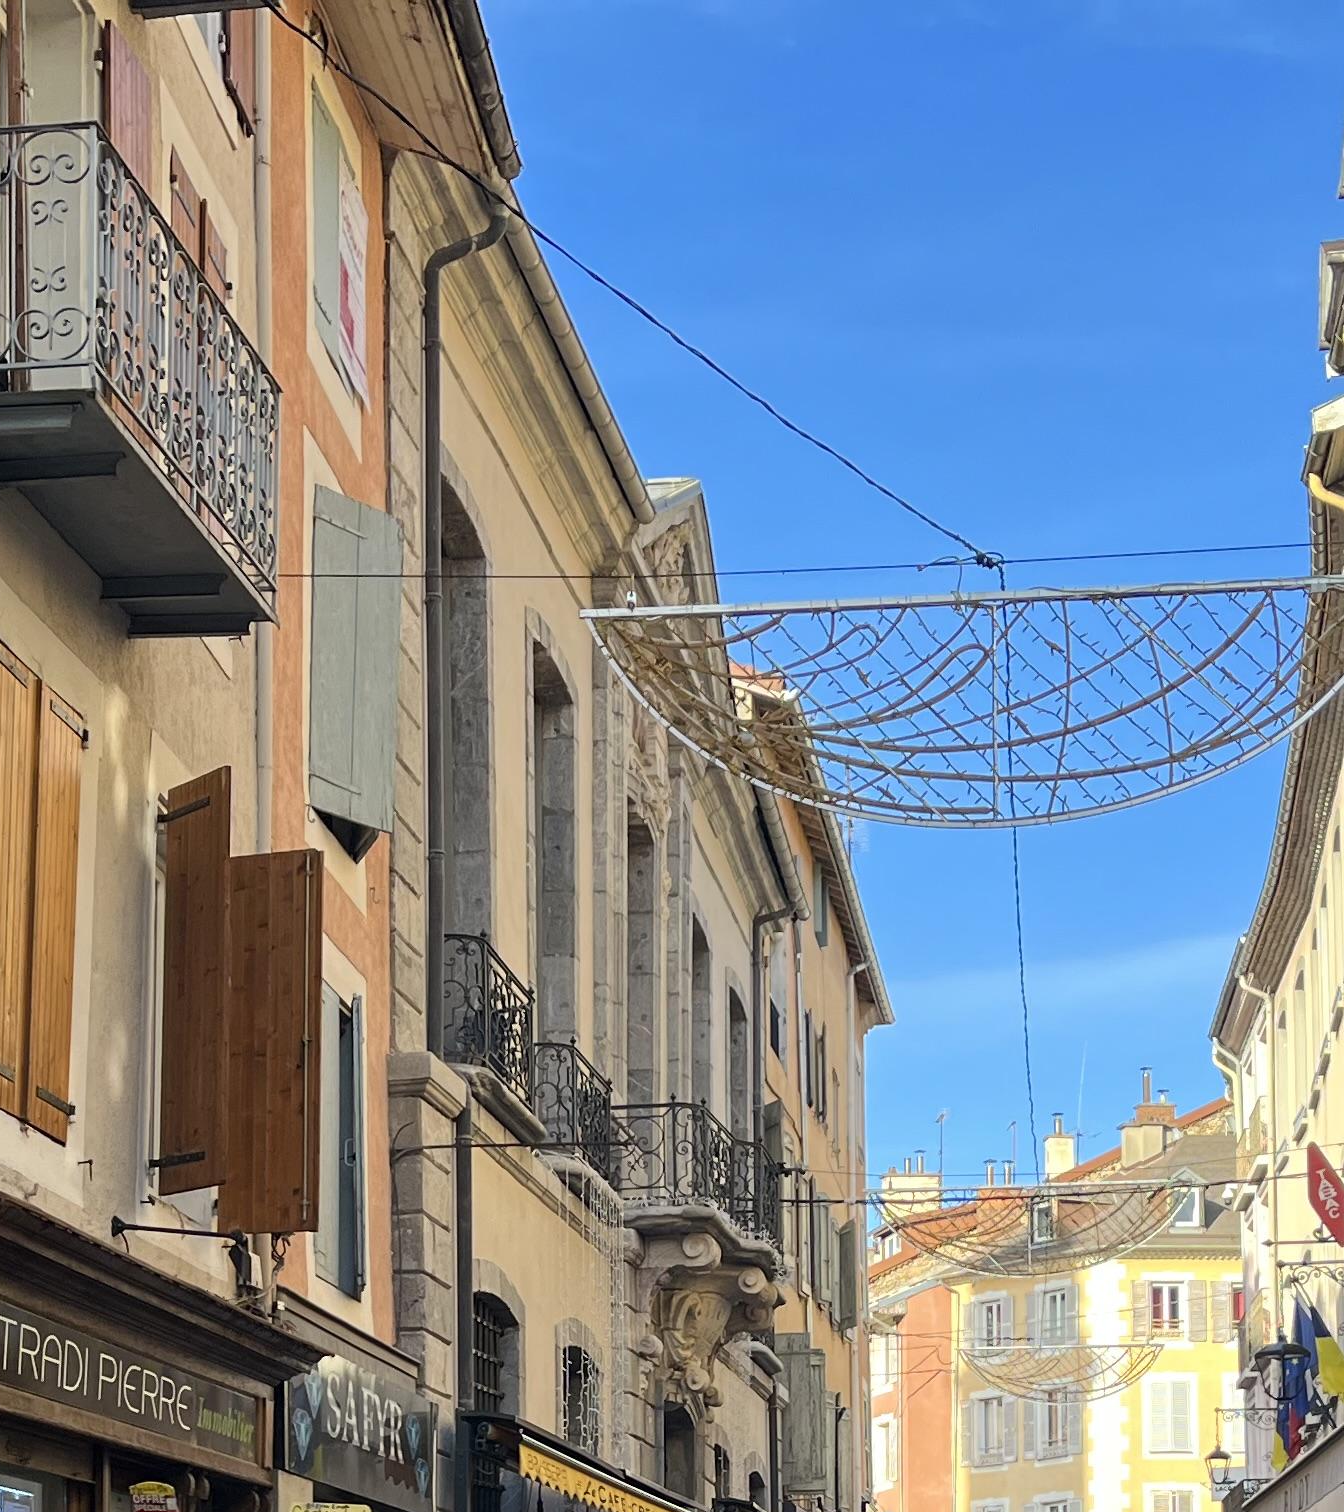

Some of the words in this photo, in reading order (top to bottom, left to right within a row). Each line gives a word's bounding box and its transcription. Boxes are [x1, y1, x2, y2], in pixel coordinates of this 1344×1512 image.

[1315, 1167, 1341, 1220] TABAC
[97, 1352, 193, 1432] PIERRE
[326, 1373, 405, 1466] SAFYR
